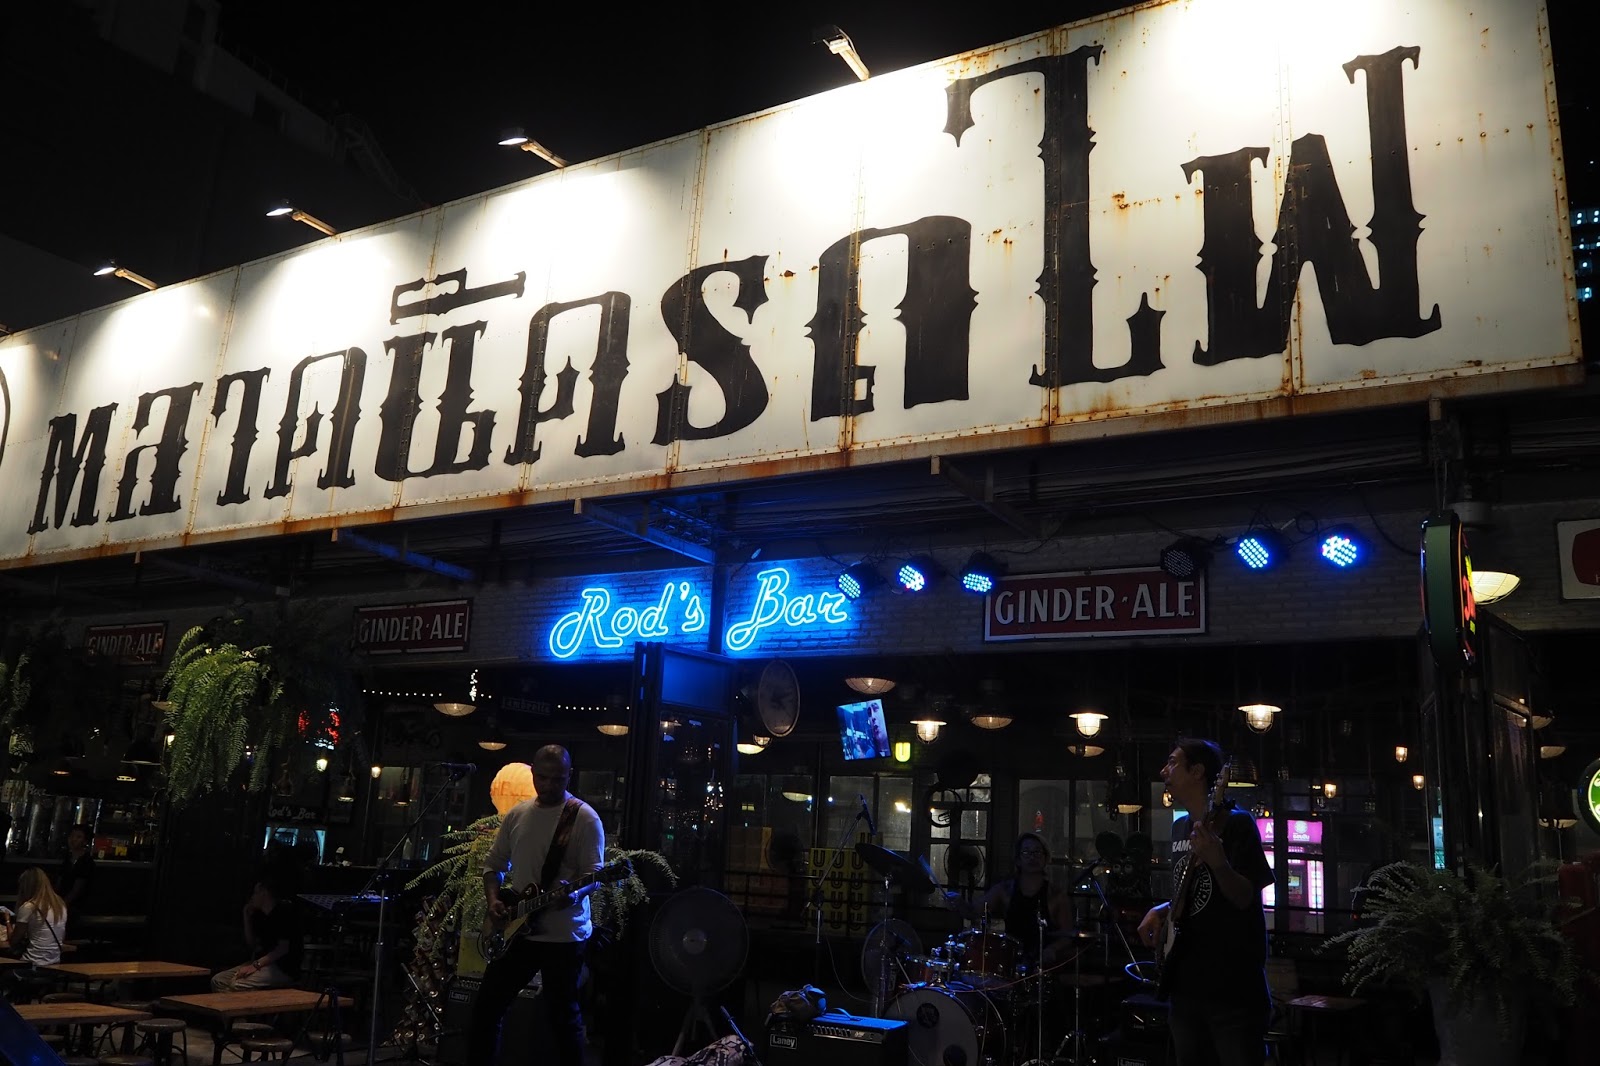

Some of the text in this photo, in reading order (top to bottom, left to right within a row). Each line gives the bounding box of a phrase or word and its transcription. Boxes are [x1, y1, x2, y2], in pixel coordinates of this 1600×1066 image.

[550, 567, 848, 659] Rod's Bar
[1131, 581, 1195, 619] ALE
[429, 612, 465, 640] ALE
[1172, 840, 1192, 852] RAM
[772, 1035, 795, 1048] Laney
